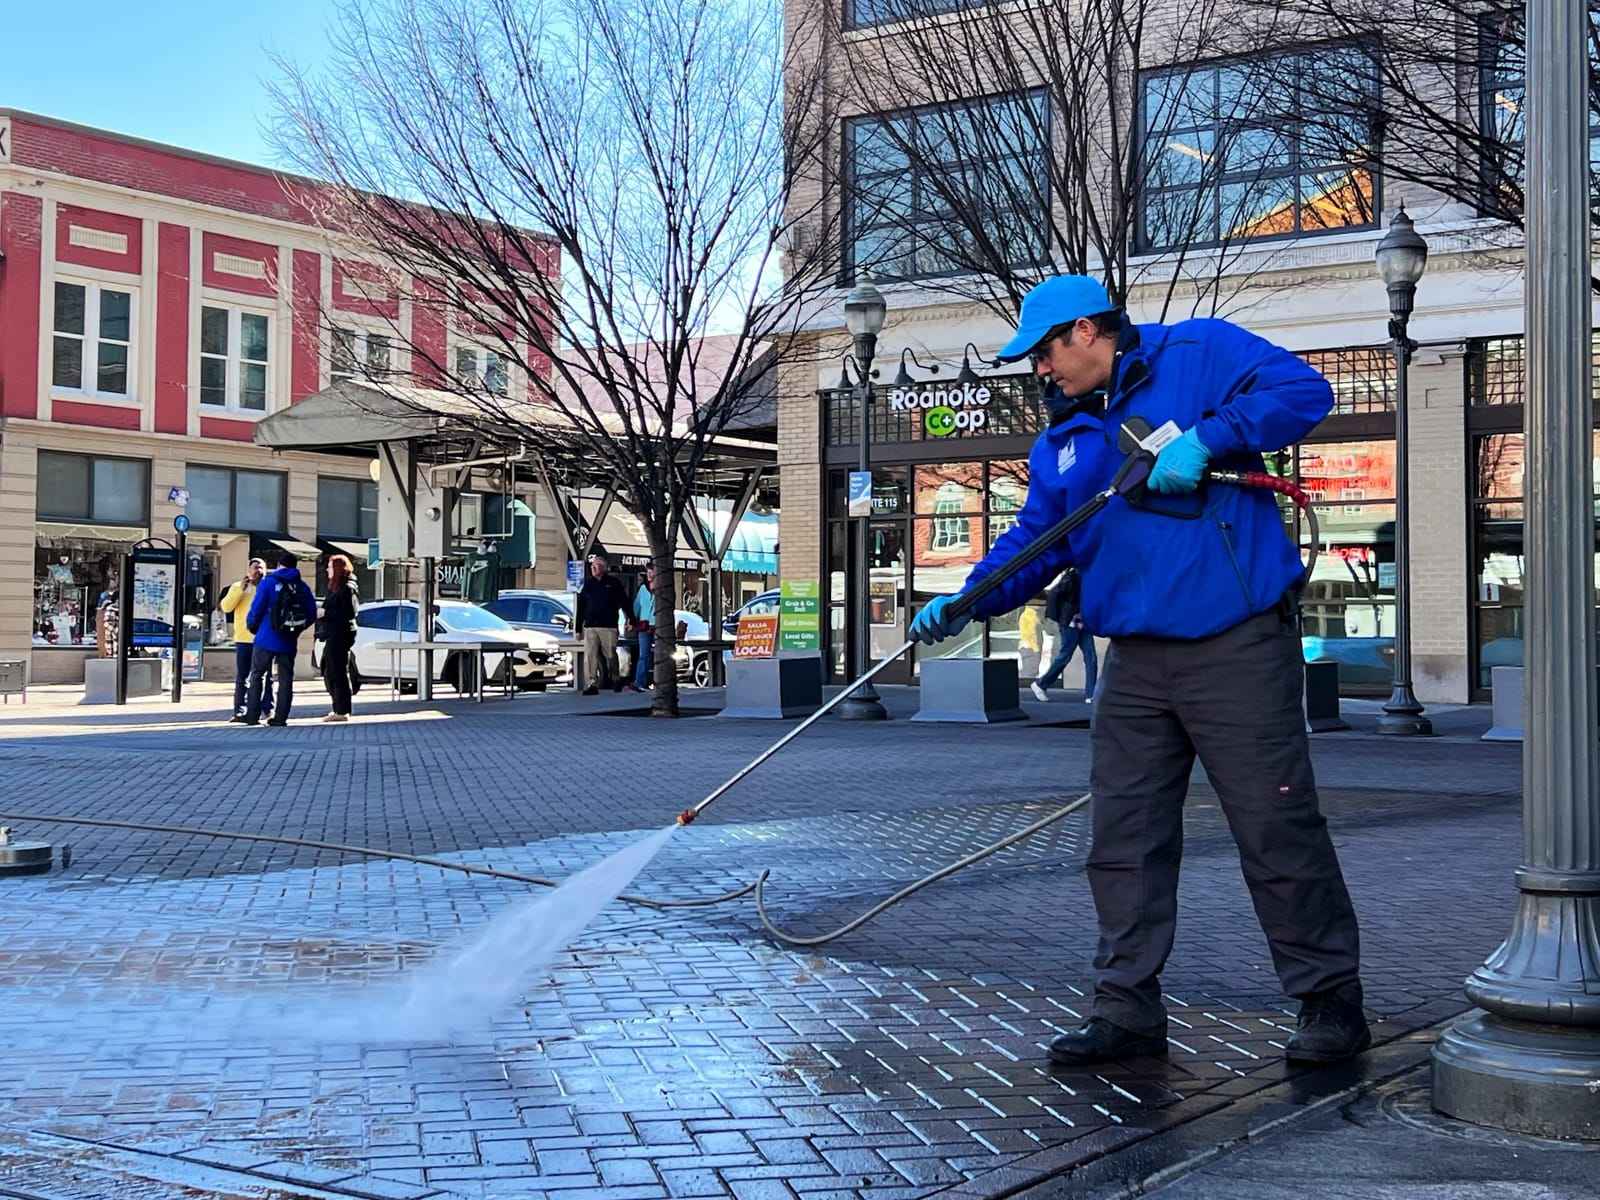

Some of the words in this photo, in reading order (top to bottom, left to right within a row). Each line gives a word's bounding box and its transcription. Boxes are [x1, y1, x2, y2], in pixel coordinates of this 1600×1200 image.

[892, 383, 991, 410] Roanoke
[871, 498, 884, 508] ITE
[885, 498, 898, 508] 115
[438, 564, 466, 582] SHAD
[735, 645, 772, 656] LOCAL
